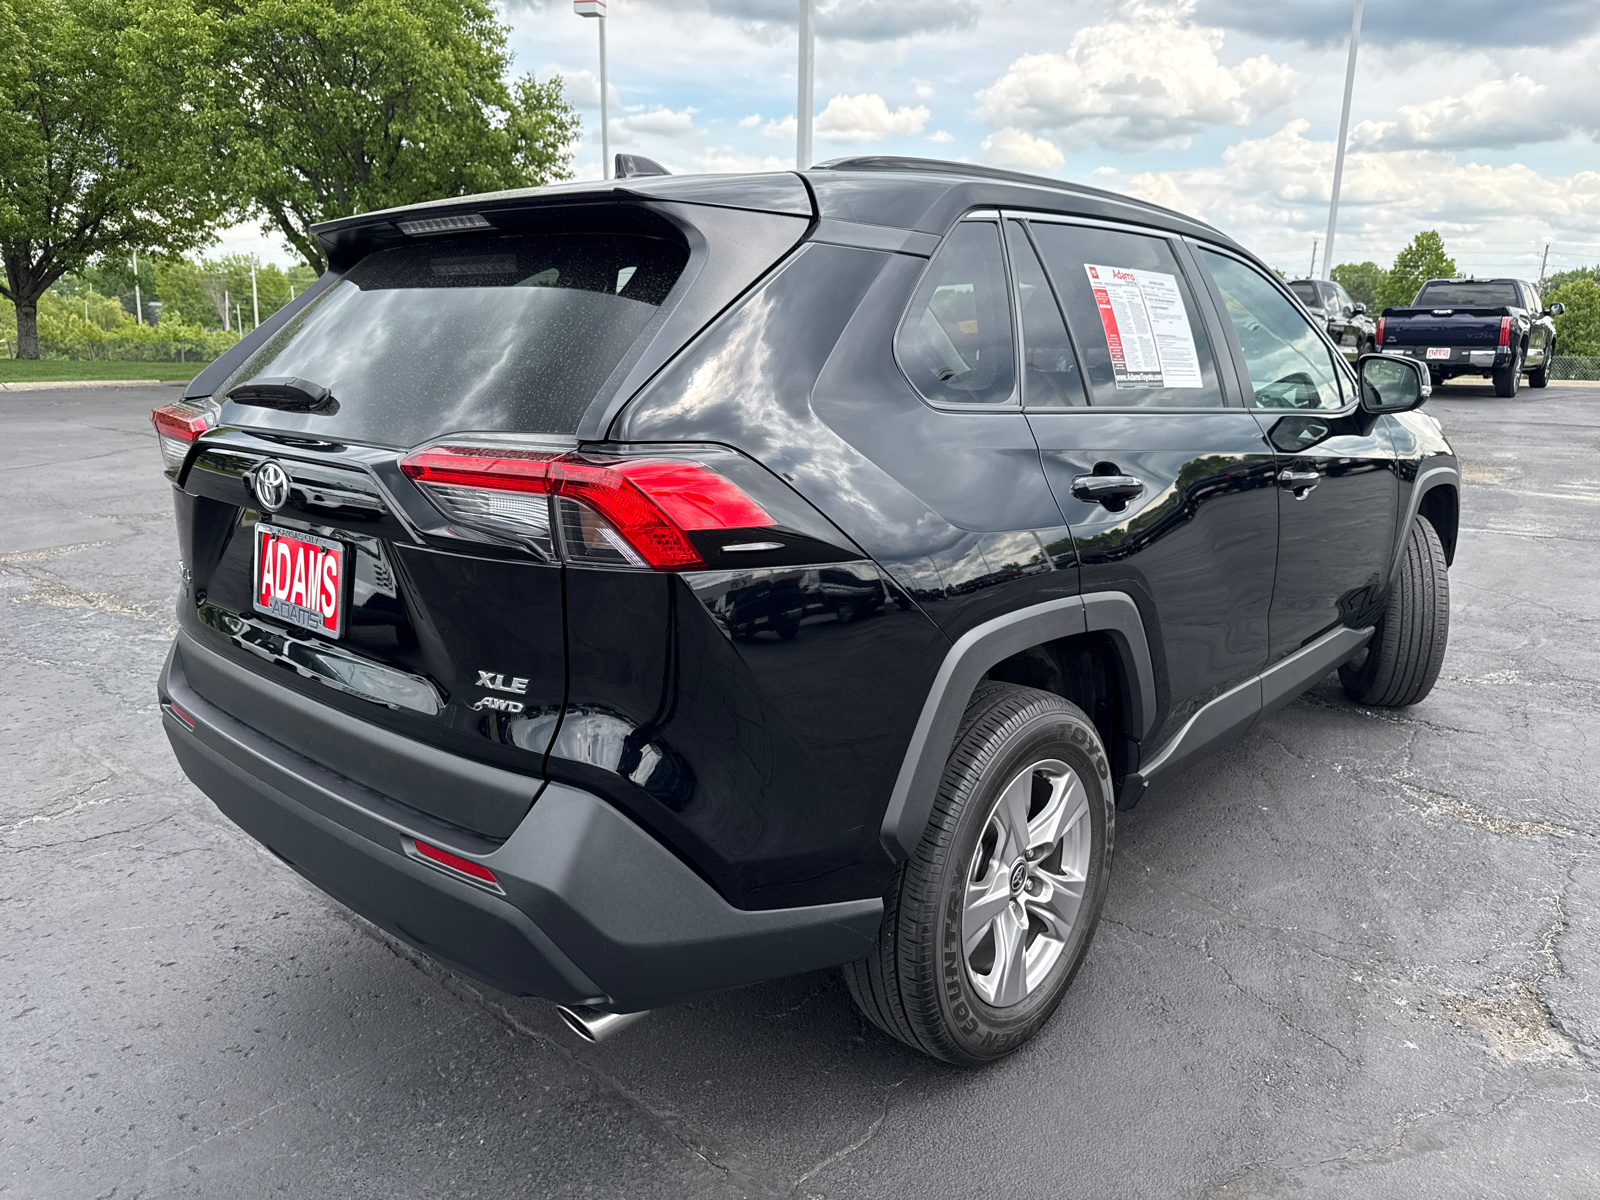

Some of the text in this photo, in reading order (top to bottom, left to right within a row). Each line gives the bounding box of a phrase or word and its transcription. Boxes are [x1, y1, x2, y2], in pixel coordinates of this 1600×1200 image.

[1112, 269, 1135, 281] Adams
[277, 528, 319, 544] KANSAS CITY
[261, 539, 337, 619] ADAMS
[272, 600, 319, 629] ADAMS
[474, 670, 530, 695] XLE
[474, 696, 524, 713] AWD
[1055, 723, 1109, 780] TOYO
[944, 860, 979, 1037] COUNTRY
[979, 1014, 1043, 1050] OPEN
